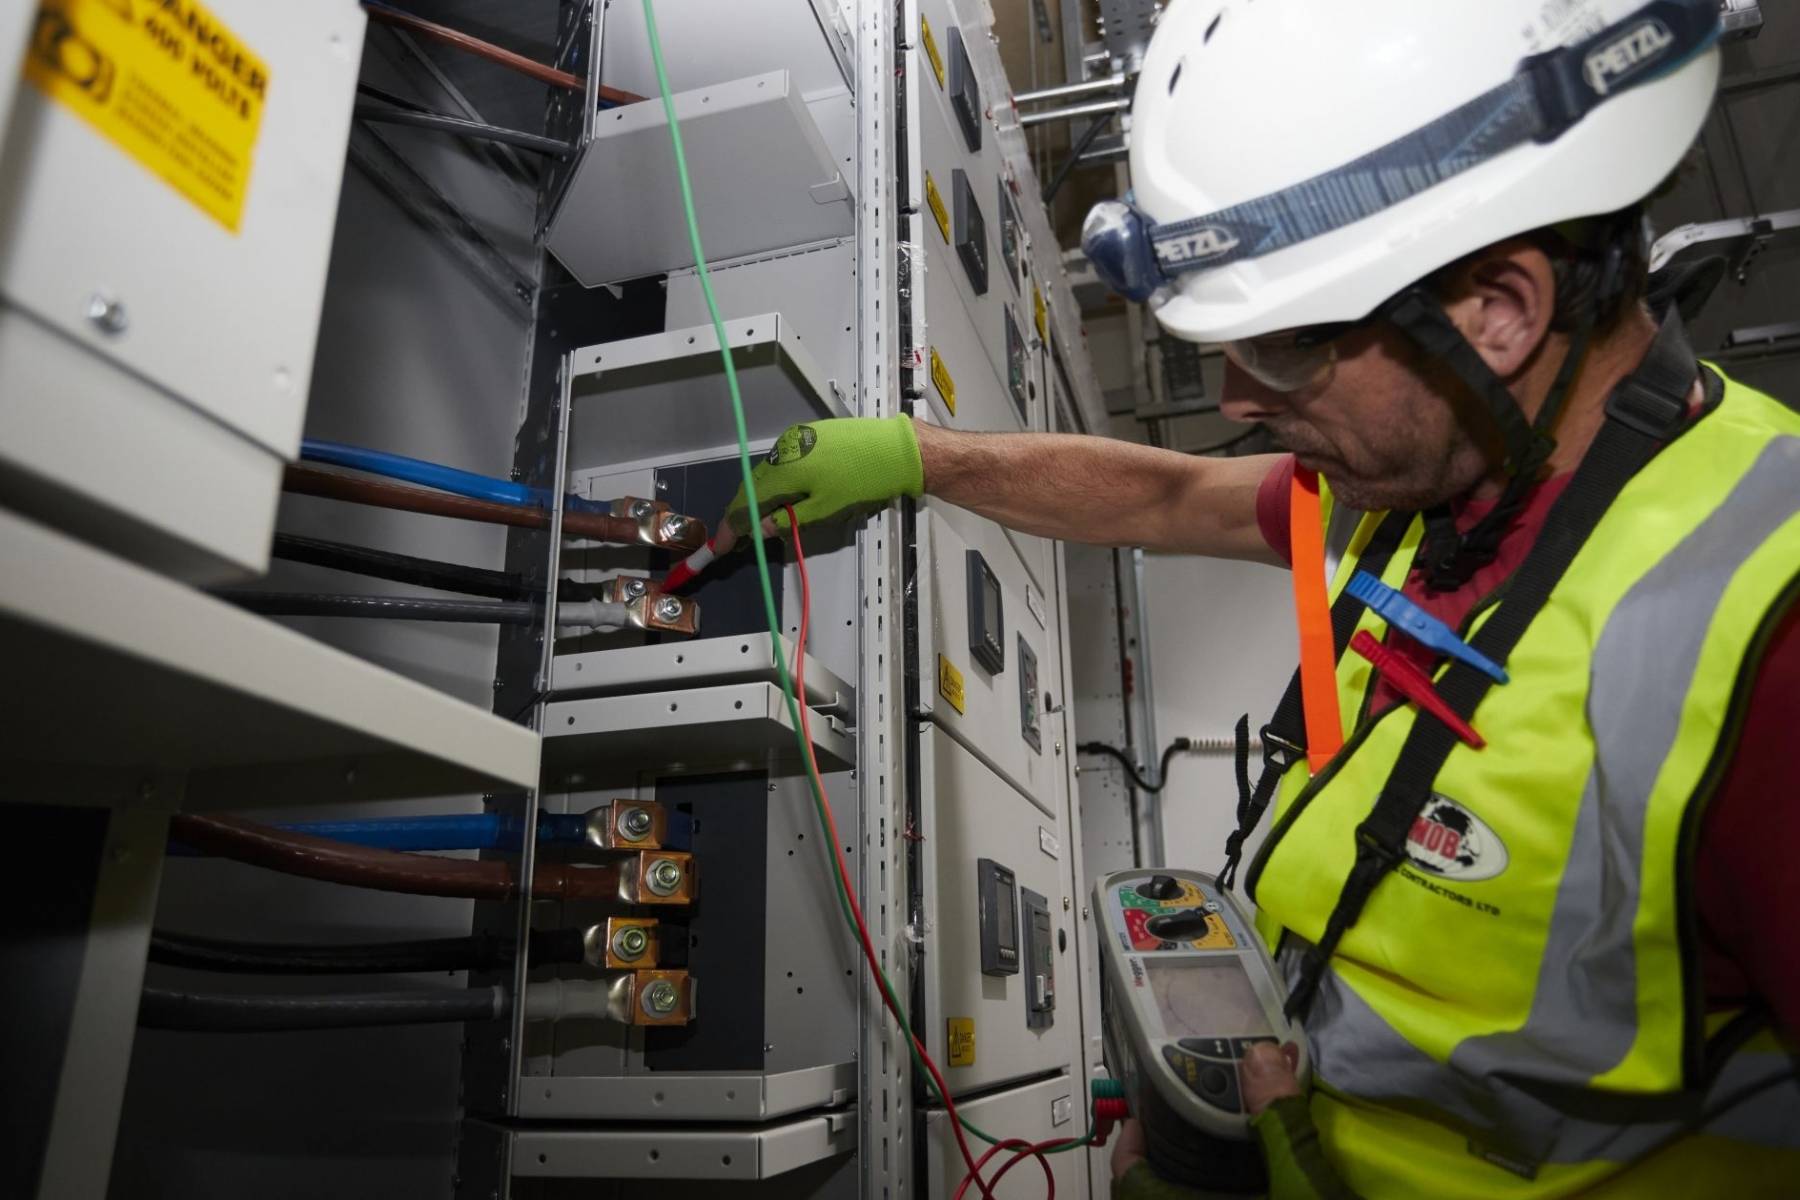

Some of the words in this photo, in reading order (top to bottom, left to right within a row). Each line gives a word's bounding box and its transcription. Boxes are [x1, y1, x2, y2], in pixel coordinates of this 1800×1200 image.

[143, 16, 185, 62] 400
[155, 0, 267, 104] ANGER
[1584, 22, 1674, 96] PETZL
[1401, 867, 1473, 907] CONTRACTORS
[1475, 901, 1501, 917] LTD
